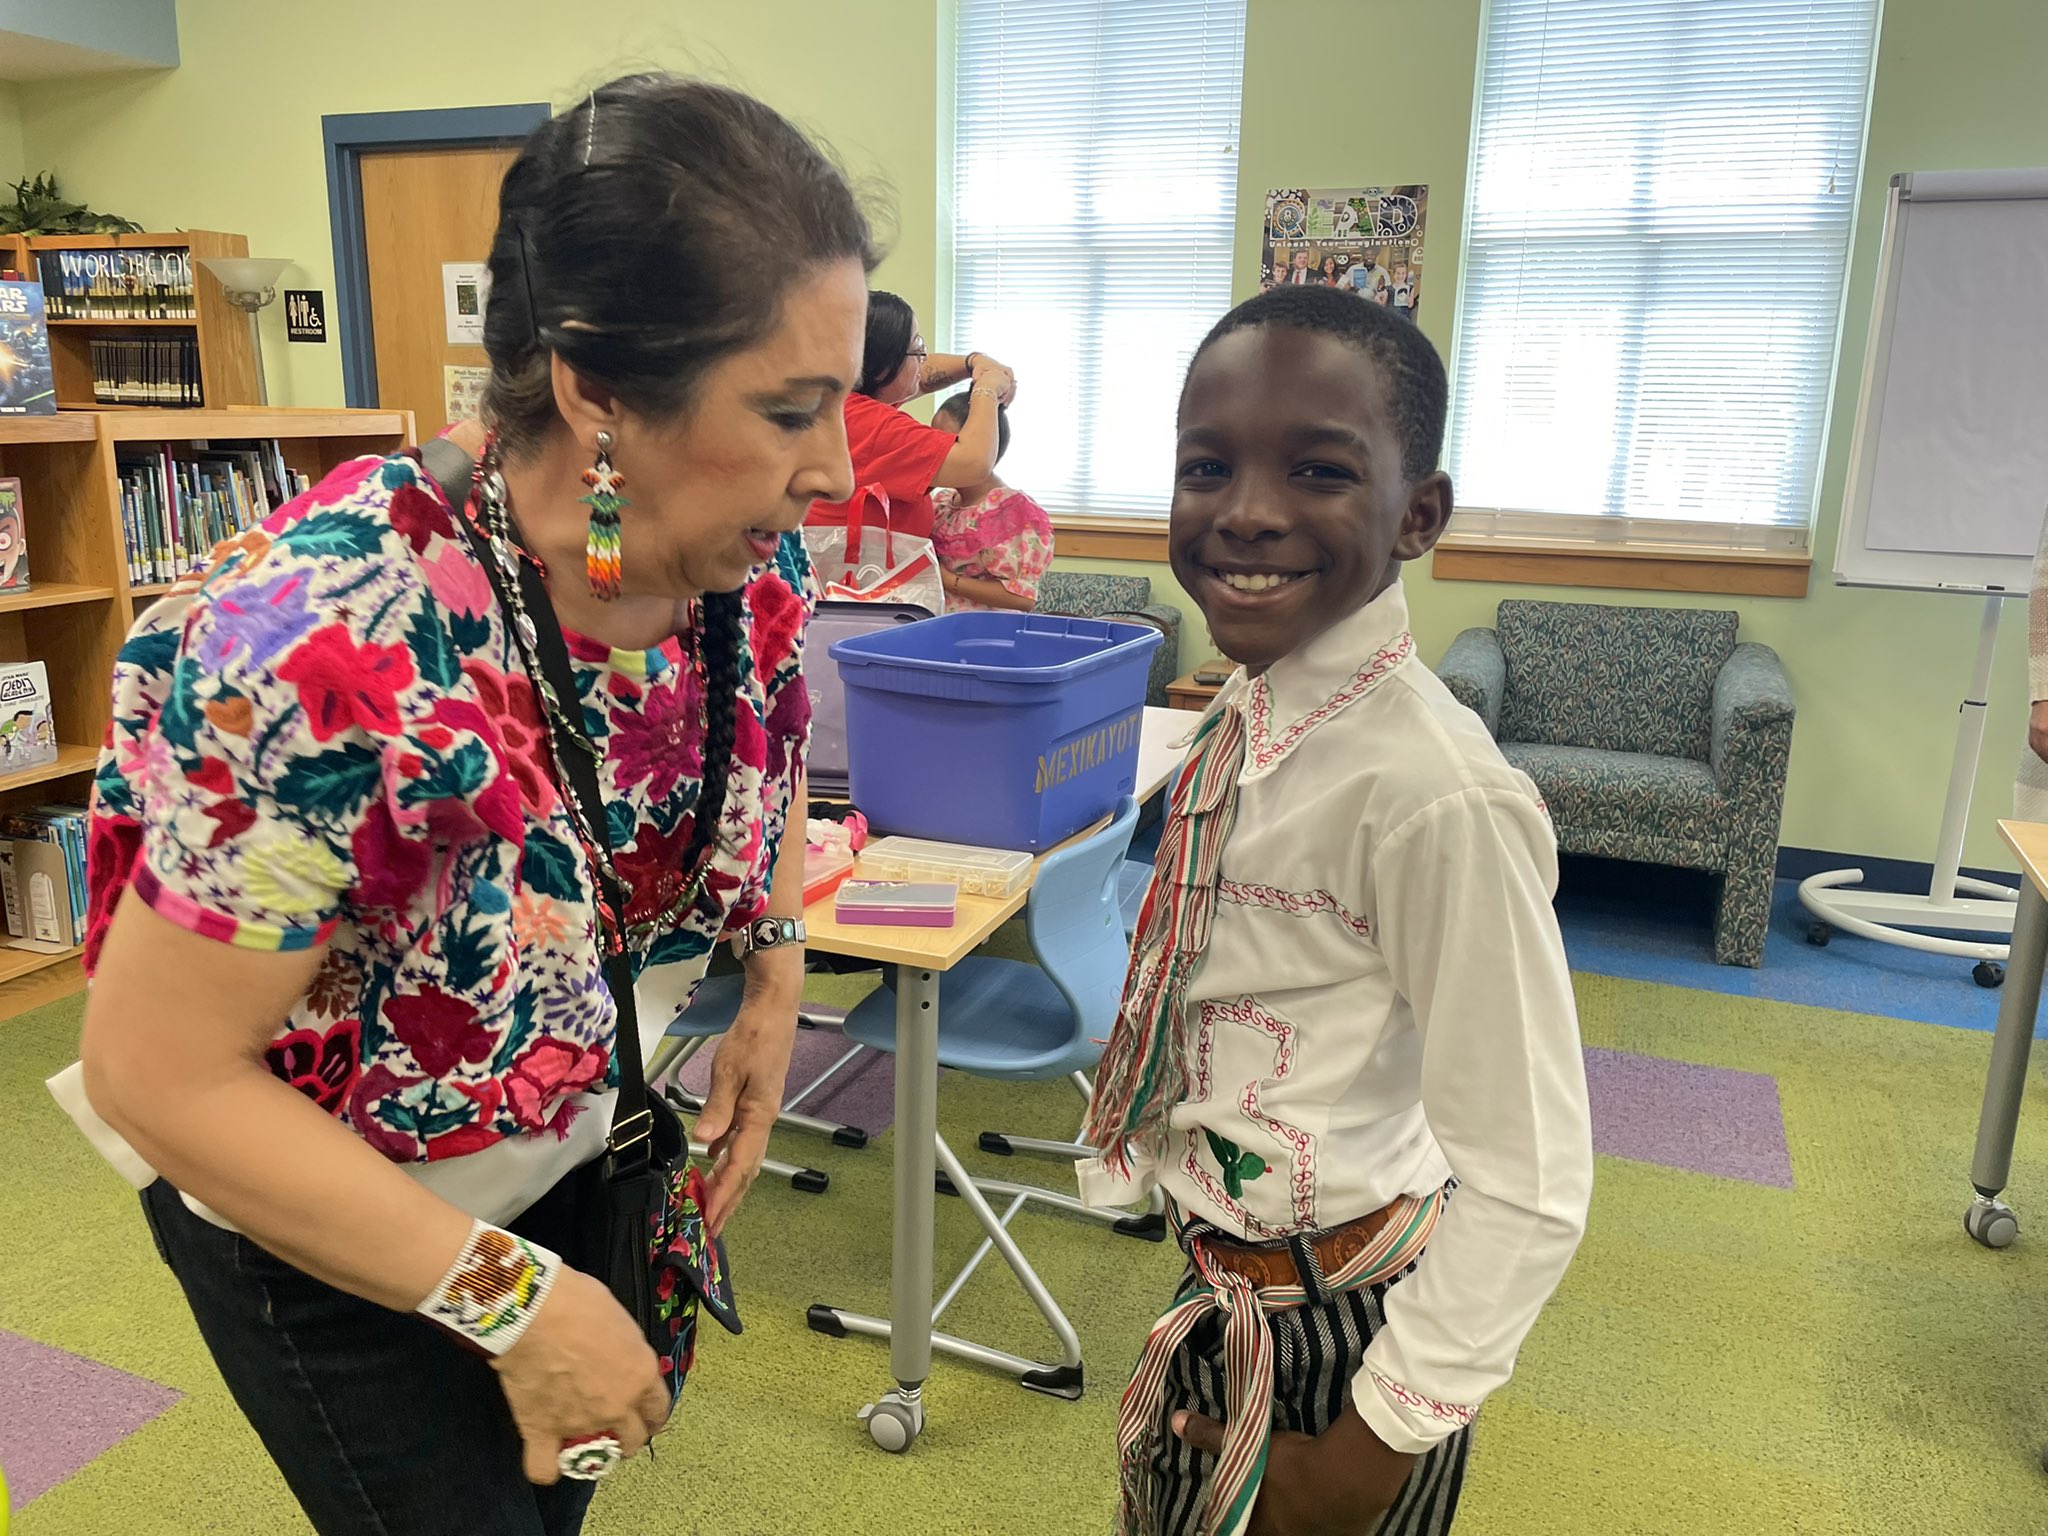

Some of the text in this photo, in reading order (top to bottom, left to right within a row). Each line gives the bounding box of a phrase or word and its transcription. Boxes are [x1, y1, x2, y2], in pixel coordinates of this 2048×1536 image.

[1269, 194, 1419, 241] READ
[0, 287, 27, 300] AR
[5, 678, 27, 692] JEDI
